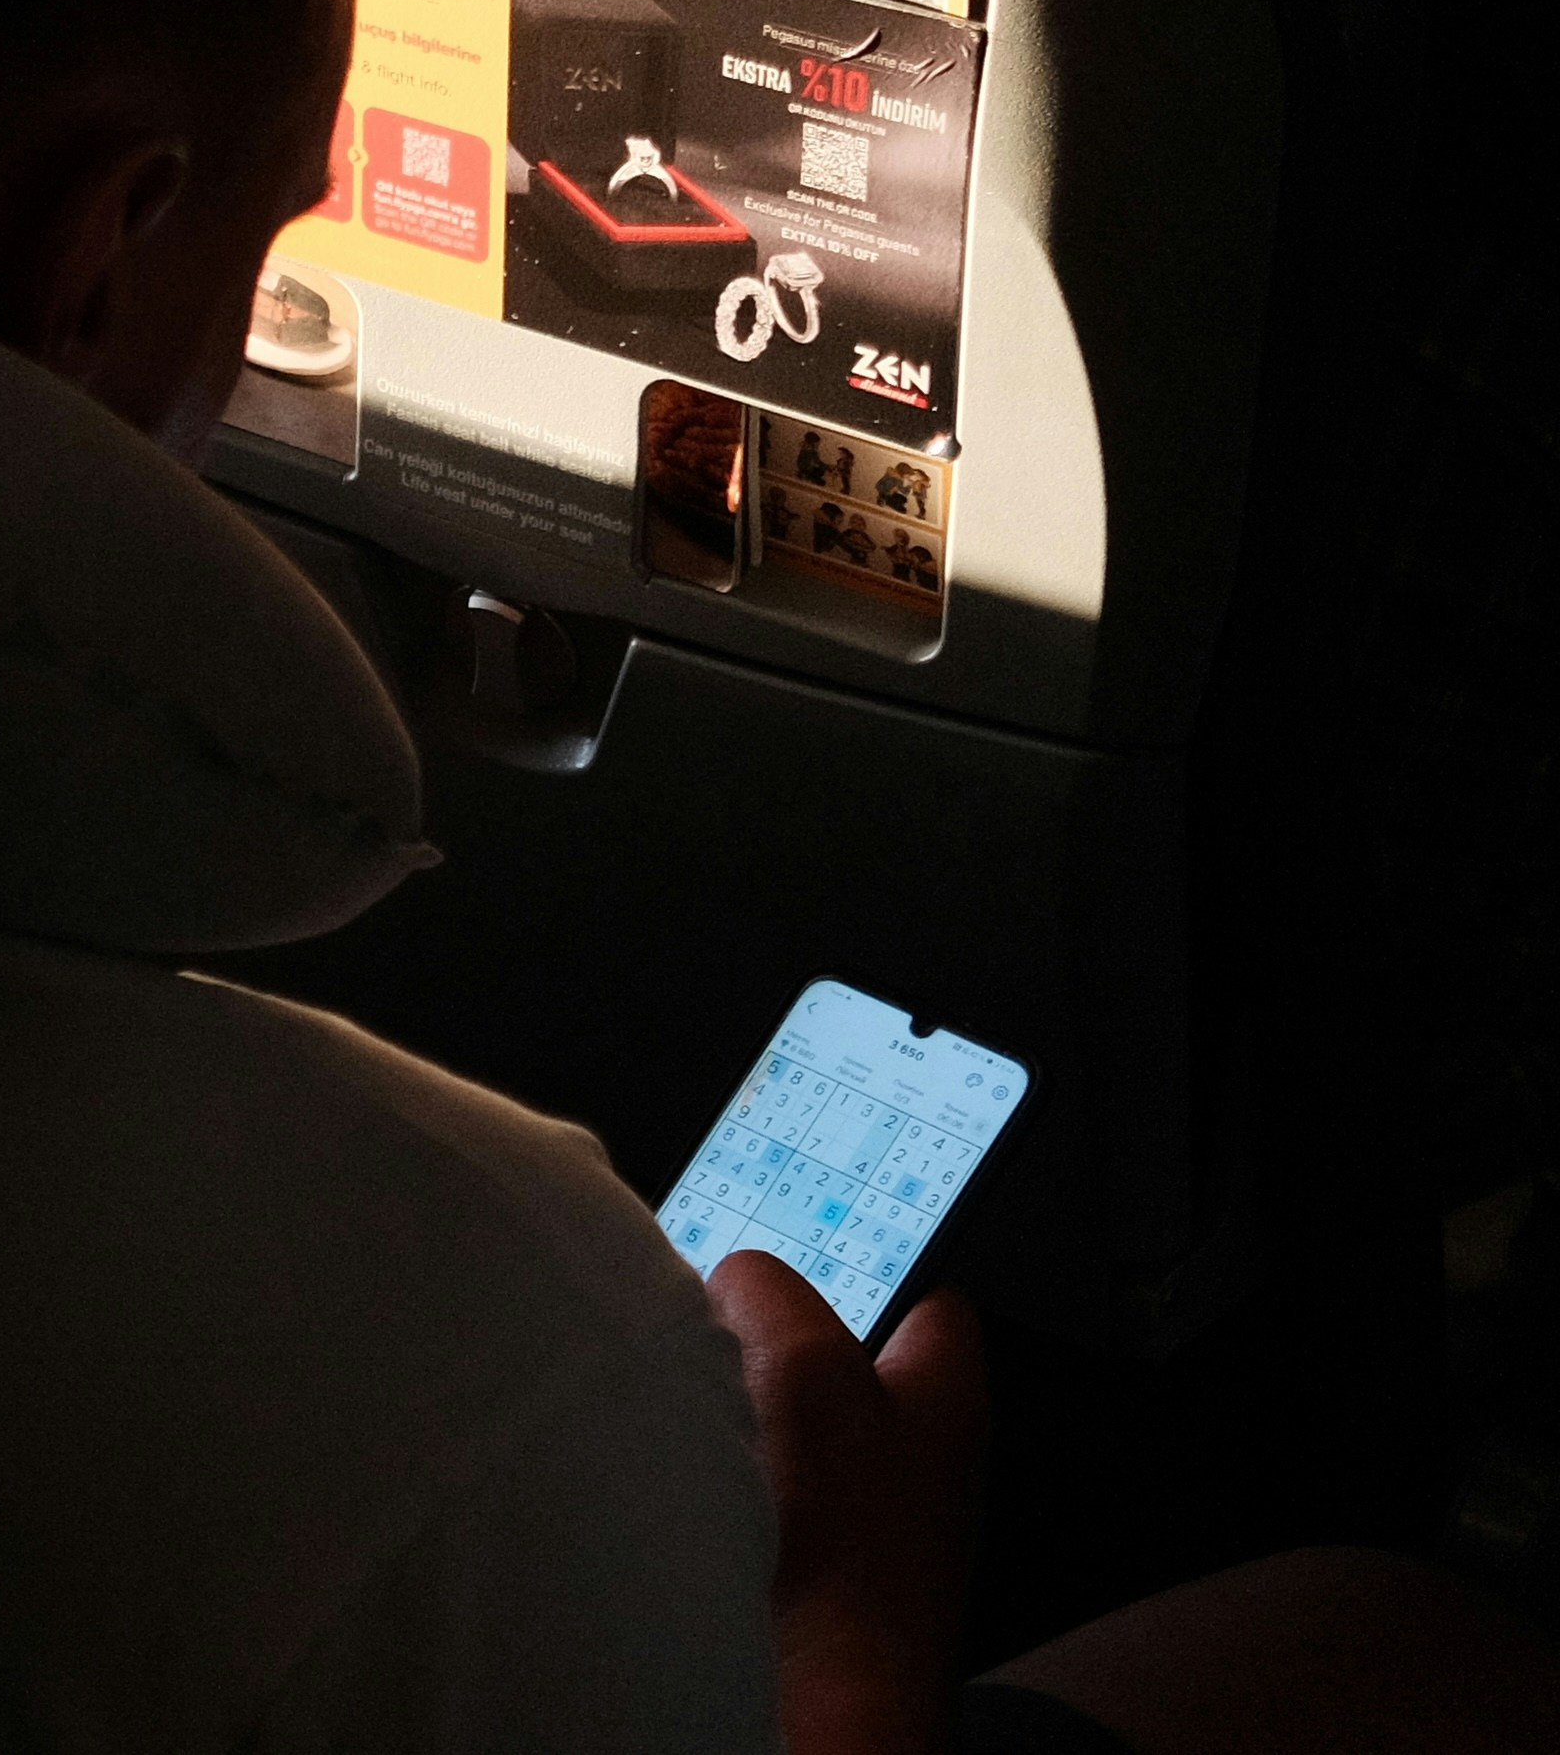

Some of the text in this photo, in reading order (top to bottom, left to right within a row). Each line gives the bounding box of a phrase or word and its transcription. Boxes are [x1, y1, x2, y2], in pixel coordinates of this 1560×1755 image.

[402, 29, 481, 65] bilgilerine
[762, 23, 816, 53] Pegasus
[722, 51, 947, 135] EKSTRA %10 İNDİRİM
[744, 194, 919, 257] Exclusive for Pegasus guests
[787, 189, 814, 206] SCAN
[816, 196, 834, 211] THE
[850, 206, 877, 224] CODE
[781, 226, 879, 264] EXTRA 10% OFF
[850, 340, 931, 396] ZEN
[363, 436, 393, 461] Can
[401, 471, 593, 546] Life vest under your seat
[752, 1083, 955, 1185] 4 3 7 2 1 6
[766, 1059, 971, 1161] 5 8 6 1 3 2 9 4 7
[723, 1127, 923, 1230] 8 6 5 4 2 7 3 9 1
[737, 1105, 940, 1208] 9 1 2 7 4 8 5 3
[707, 1150, 910, 1254] 2 4 3 9 1 5 7 6 8
